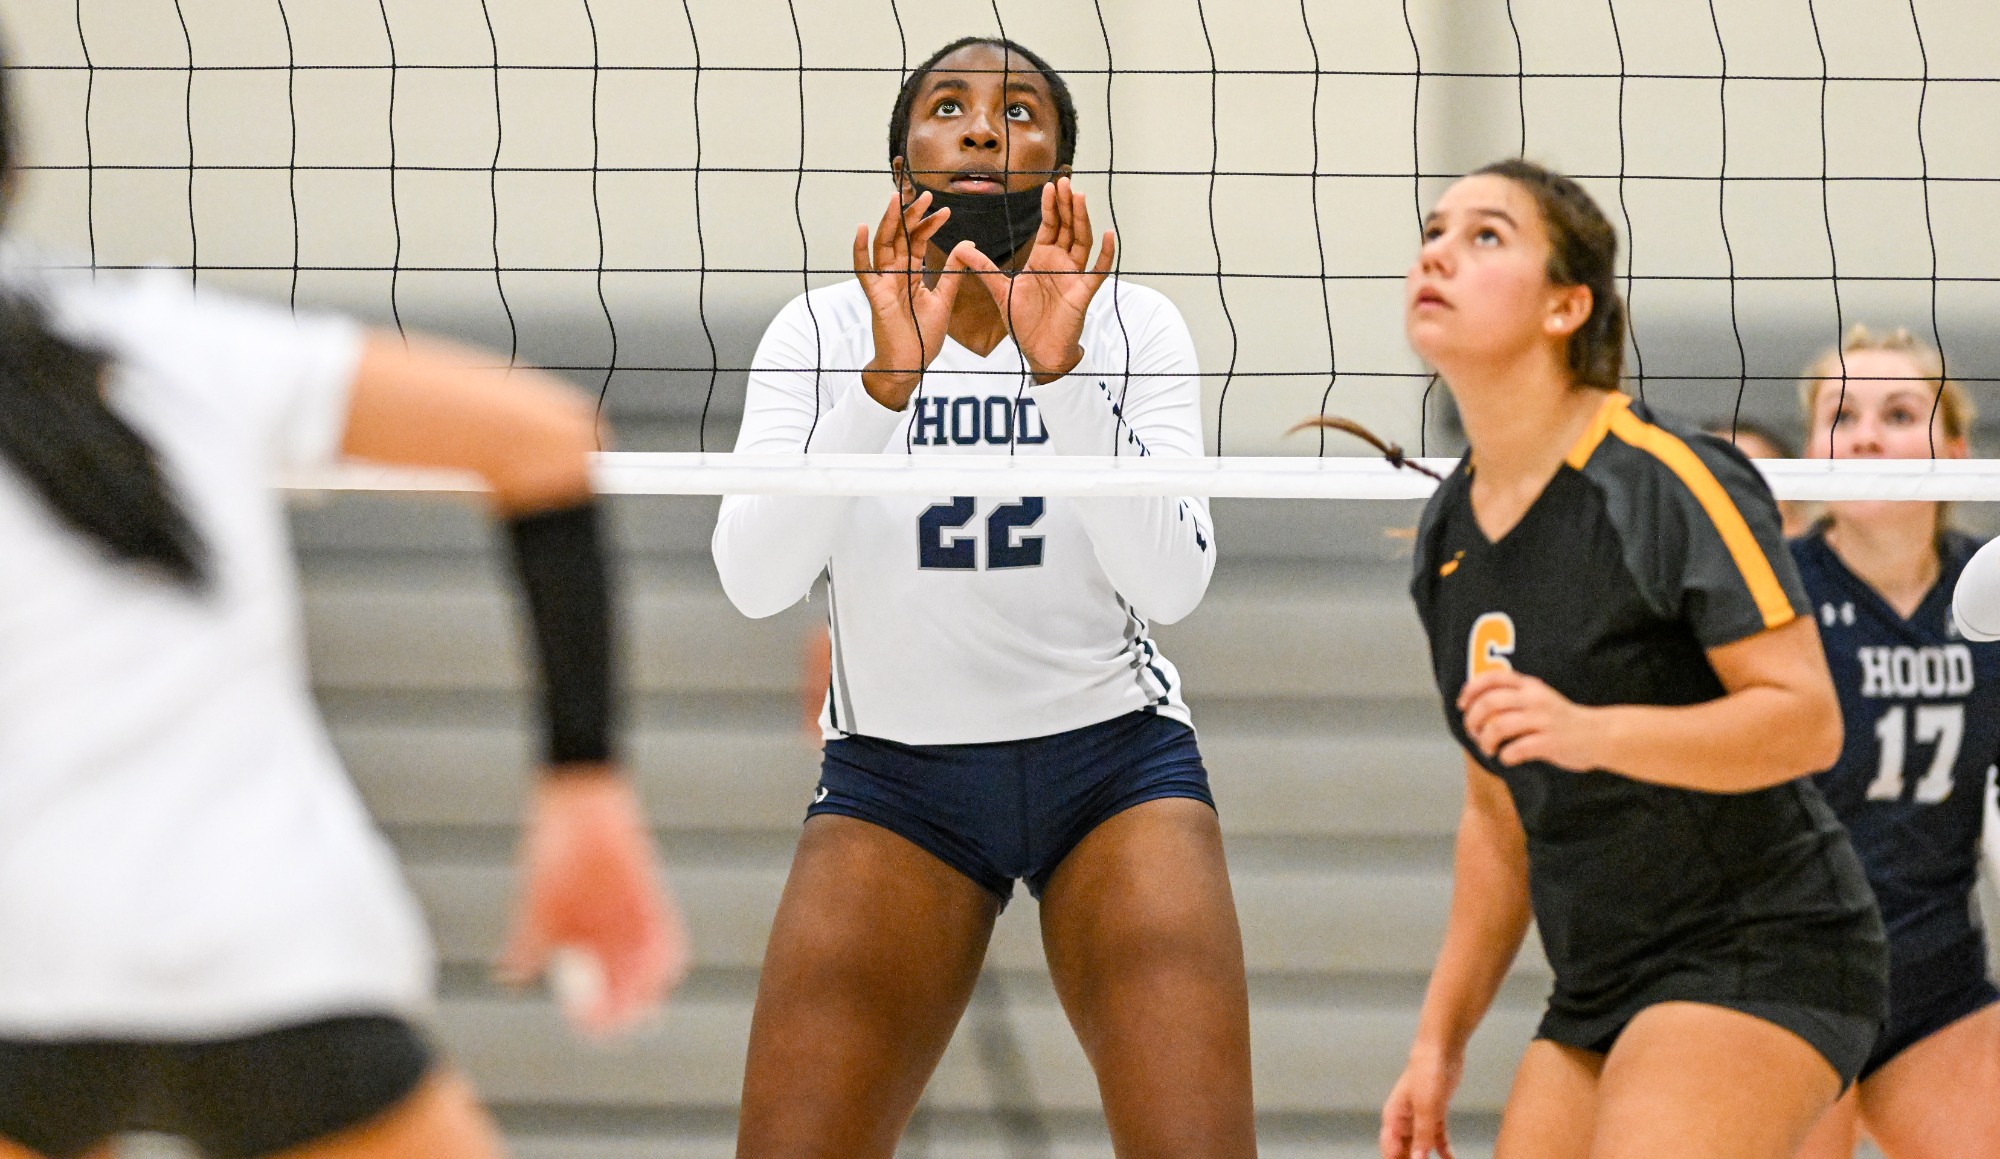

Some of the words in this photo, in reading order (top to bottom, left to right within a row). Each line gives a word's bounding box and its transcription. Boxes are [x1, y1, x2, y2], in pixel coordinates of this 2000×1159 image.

[912, 395, 1049, 445] HOOD
[916, 496, 1046, 571] 22
[1857, 644, 1975, 698] HOOD
[1865, 703, 1965, 804] 17
